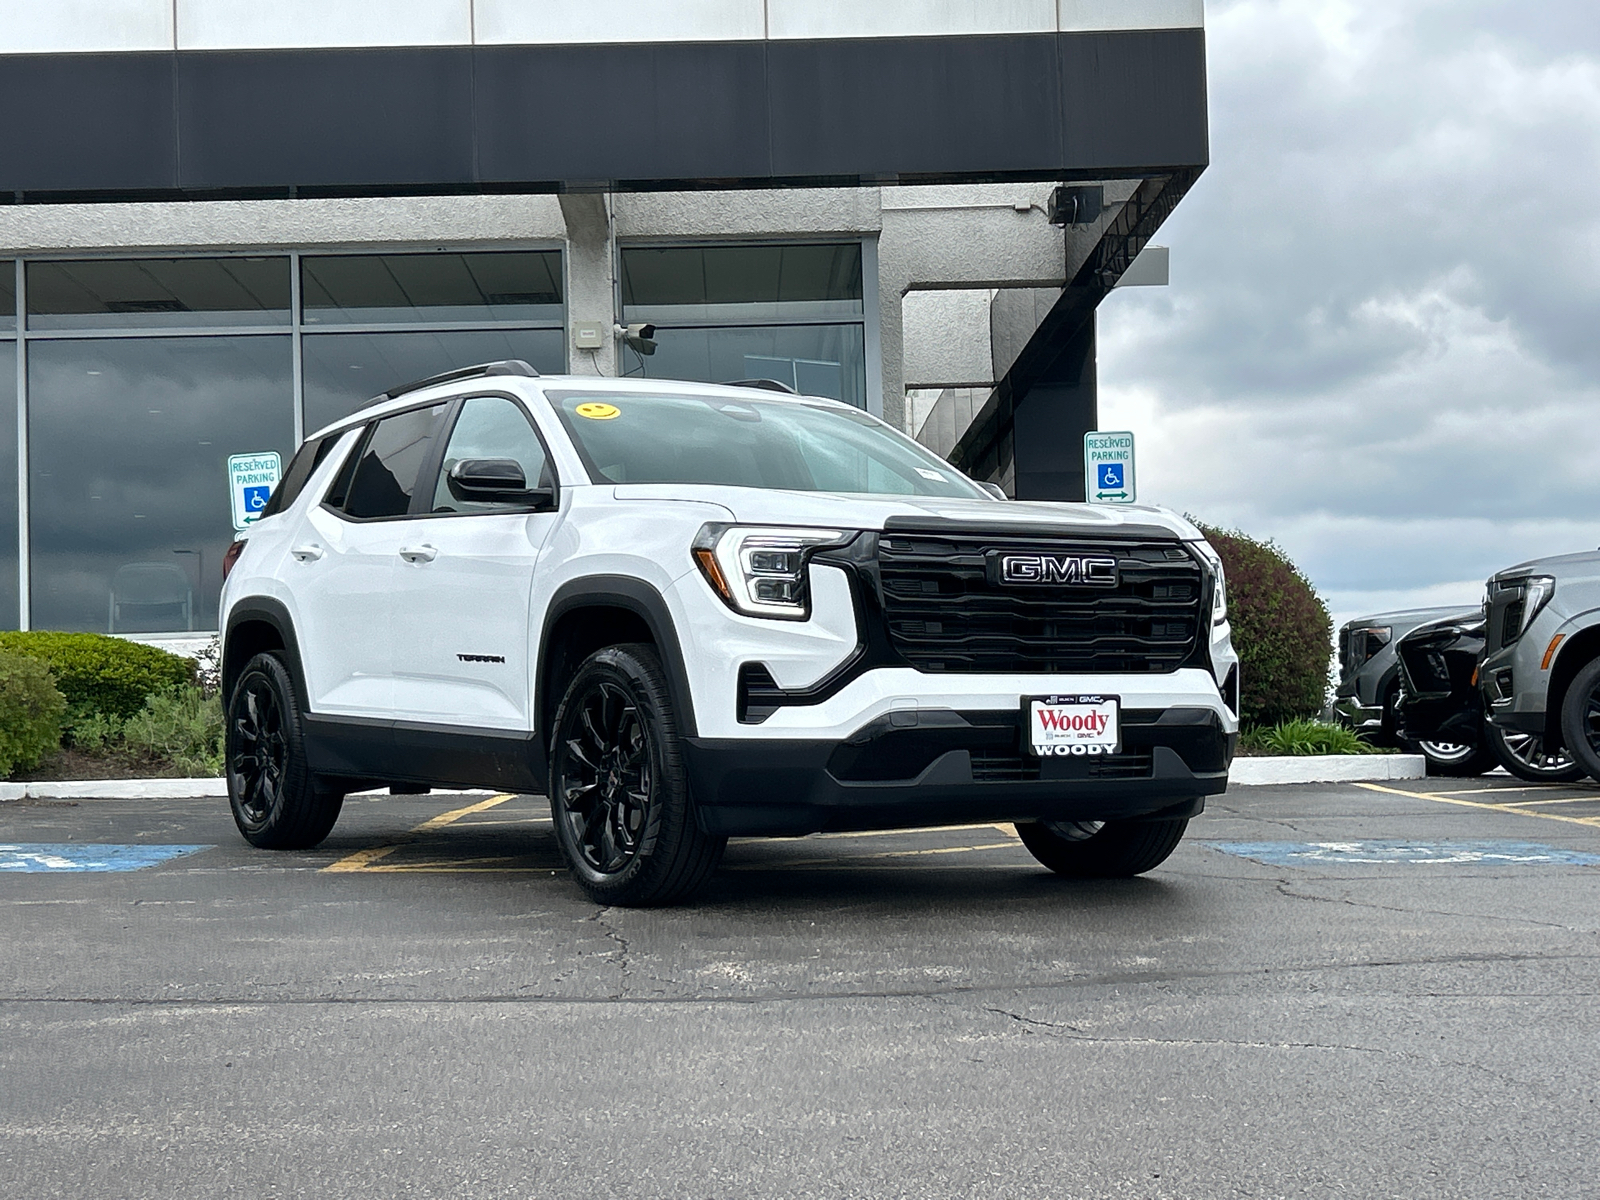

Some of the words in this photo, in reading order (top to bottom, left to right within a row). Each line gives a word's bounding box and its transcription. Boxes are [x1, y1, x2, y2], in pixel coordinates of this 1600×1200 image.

[1089, 438, 1131, 449] RESERVED
[1092, 451, 1129, 461] PARKING
[233, 460, 276, 472] RESERVED
[236, 472, 275, 484] PARKING
[1002, 556, 1116, 583] GMC
[1037, 709, 1110, 736] Woody
[1034, 743, 1117, 756] WOODY
